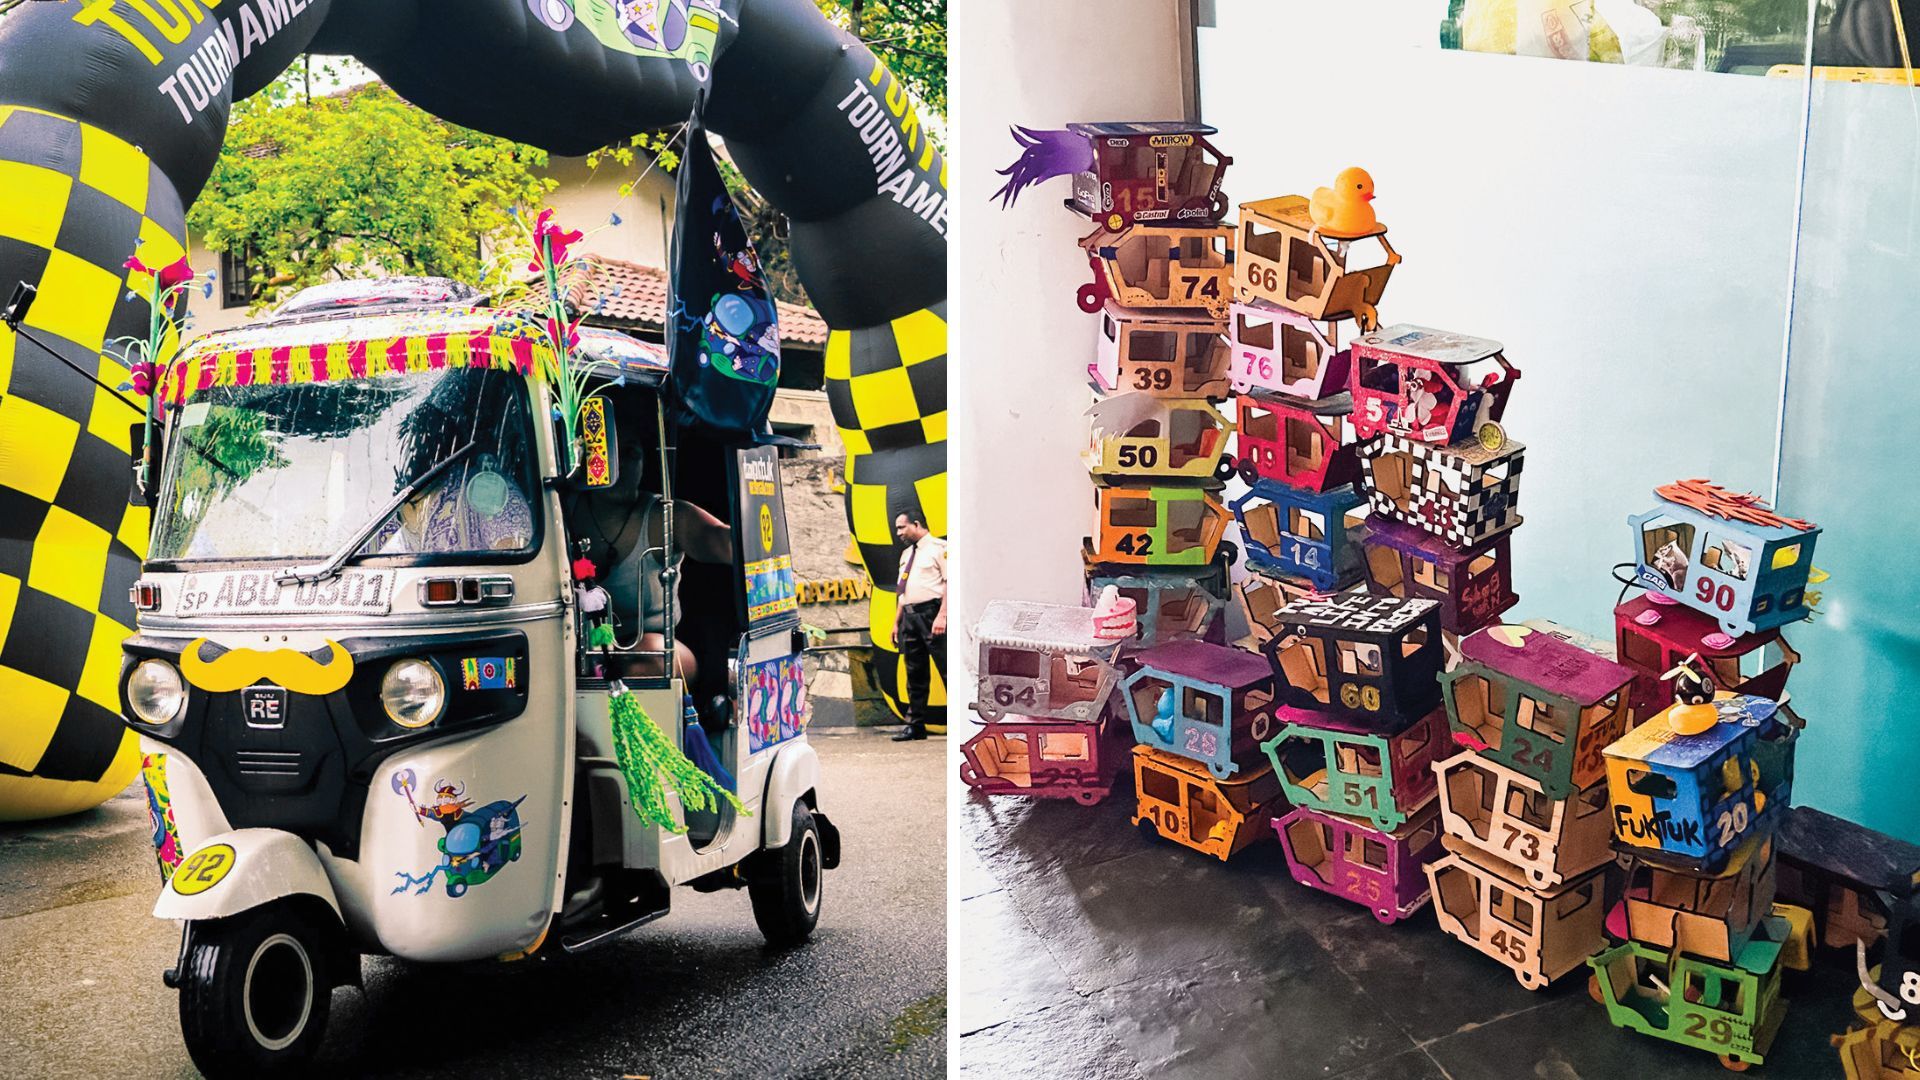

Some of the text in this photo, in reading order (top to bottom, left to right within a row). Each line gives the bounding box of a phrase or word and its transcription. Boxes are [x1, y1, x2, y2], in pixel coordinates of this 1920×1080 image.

[158, 0, 315, 125] TOURNAME
[837, 78, 947, 242] TOURNAME
[1117, 187, 1155, 213] 15
[1182, 276, 1220, 300] 74
[1248, 262, 1278, 293] 66
[1133, 367, 1173, 391] 39
[1242, 351, 1274, 380] 76
[1118, 445, 1158, 468] 50
[763, 513, 772, 542] 92
[1115, 533, 1154, 556] 42
[1291, 543, 1320, 570] 14
[182, 592, 208, 610] SP
[1695, 576, 1736, 612] 90
[250, 699, 280, 719] RE
[993, 684, 1037, 707] 64
[1340, 682, 1381, 711] 60
[1510, 737, 1553, 773] 24
[1343, 782, 1379, 811] 51
[1149, 803, 1180, 834] 10
[1717, 802, 1748, 848] 20
[1502, 822, 1541, 862] 73
[180, 851, 227, 884] 92
[1346, 870, 1382, 902] 25
[1490, 929, 1527, 964] 45
[1684, 1012, 1733, 1046] 29
